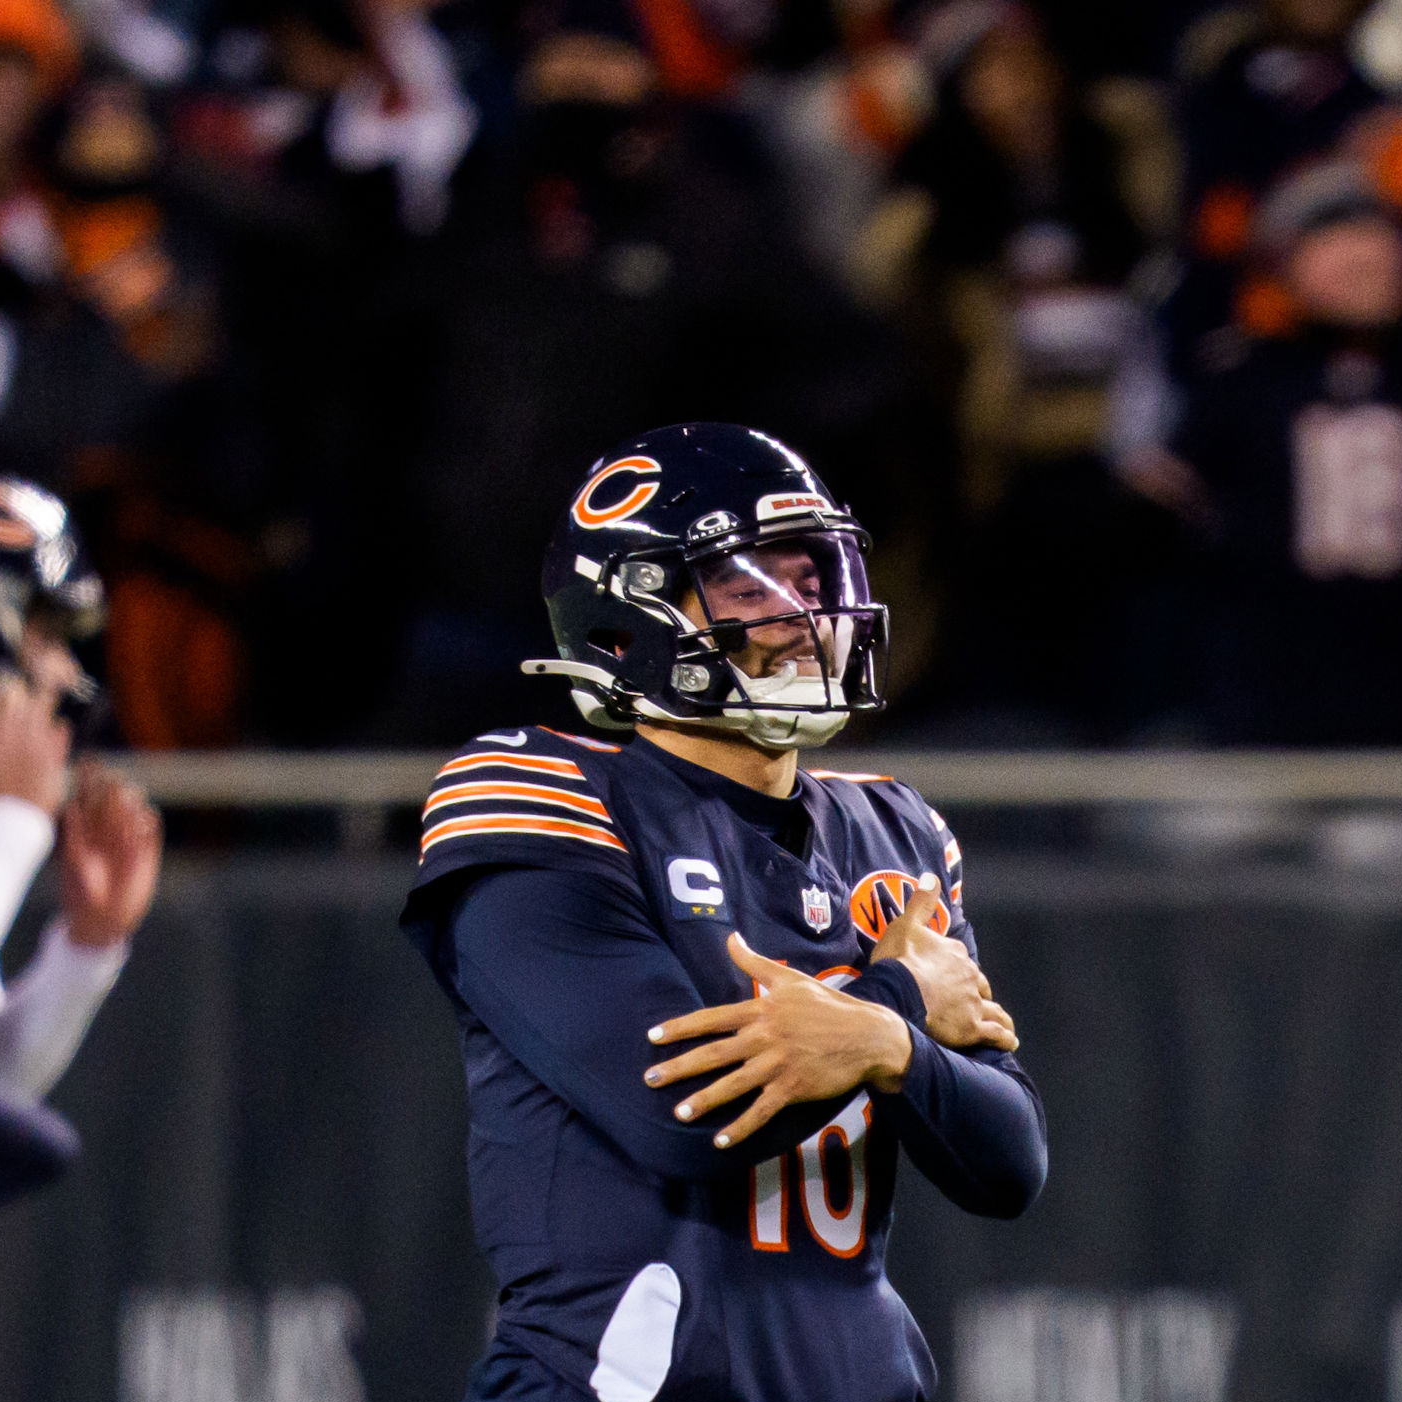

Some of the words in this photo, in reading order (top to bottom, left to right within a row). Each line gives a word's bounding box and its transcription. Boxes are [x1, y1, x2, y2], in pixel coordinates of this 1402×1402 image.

[572, 456, 662, 529] C
[771, 497, 825, 511] BEARS
[668, 858, 724, 905] C
[809, 906, 828, 924] NFL
